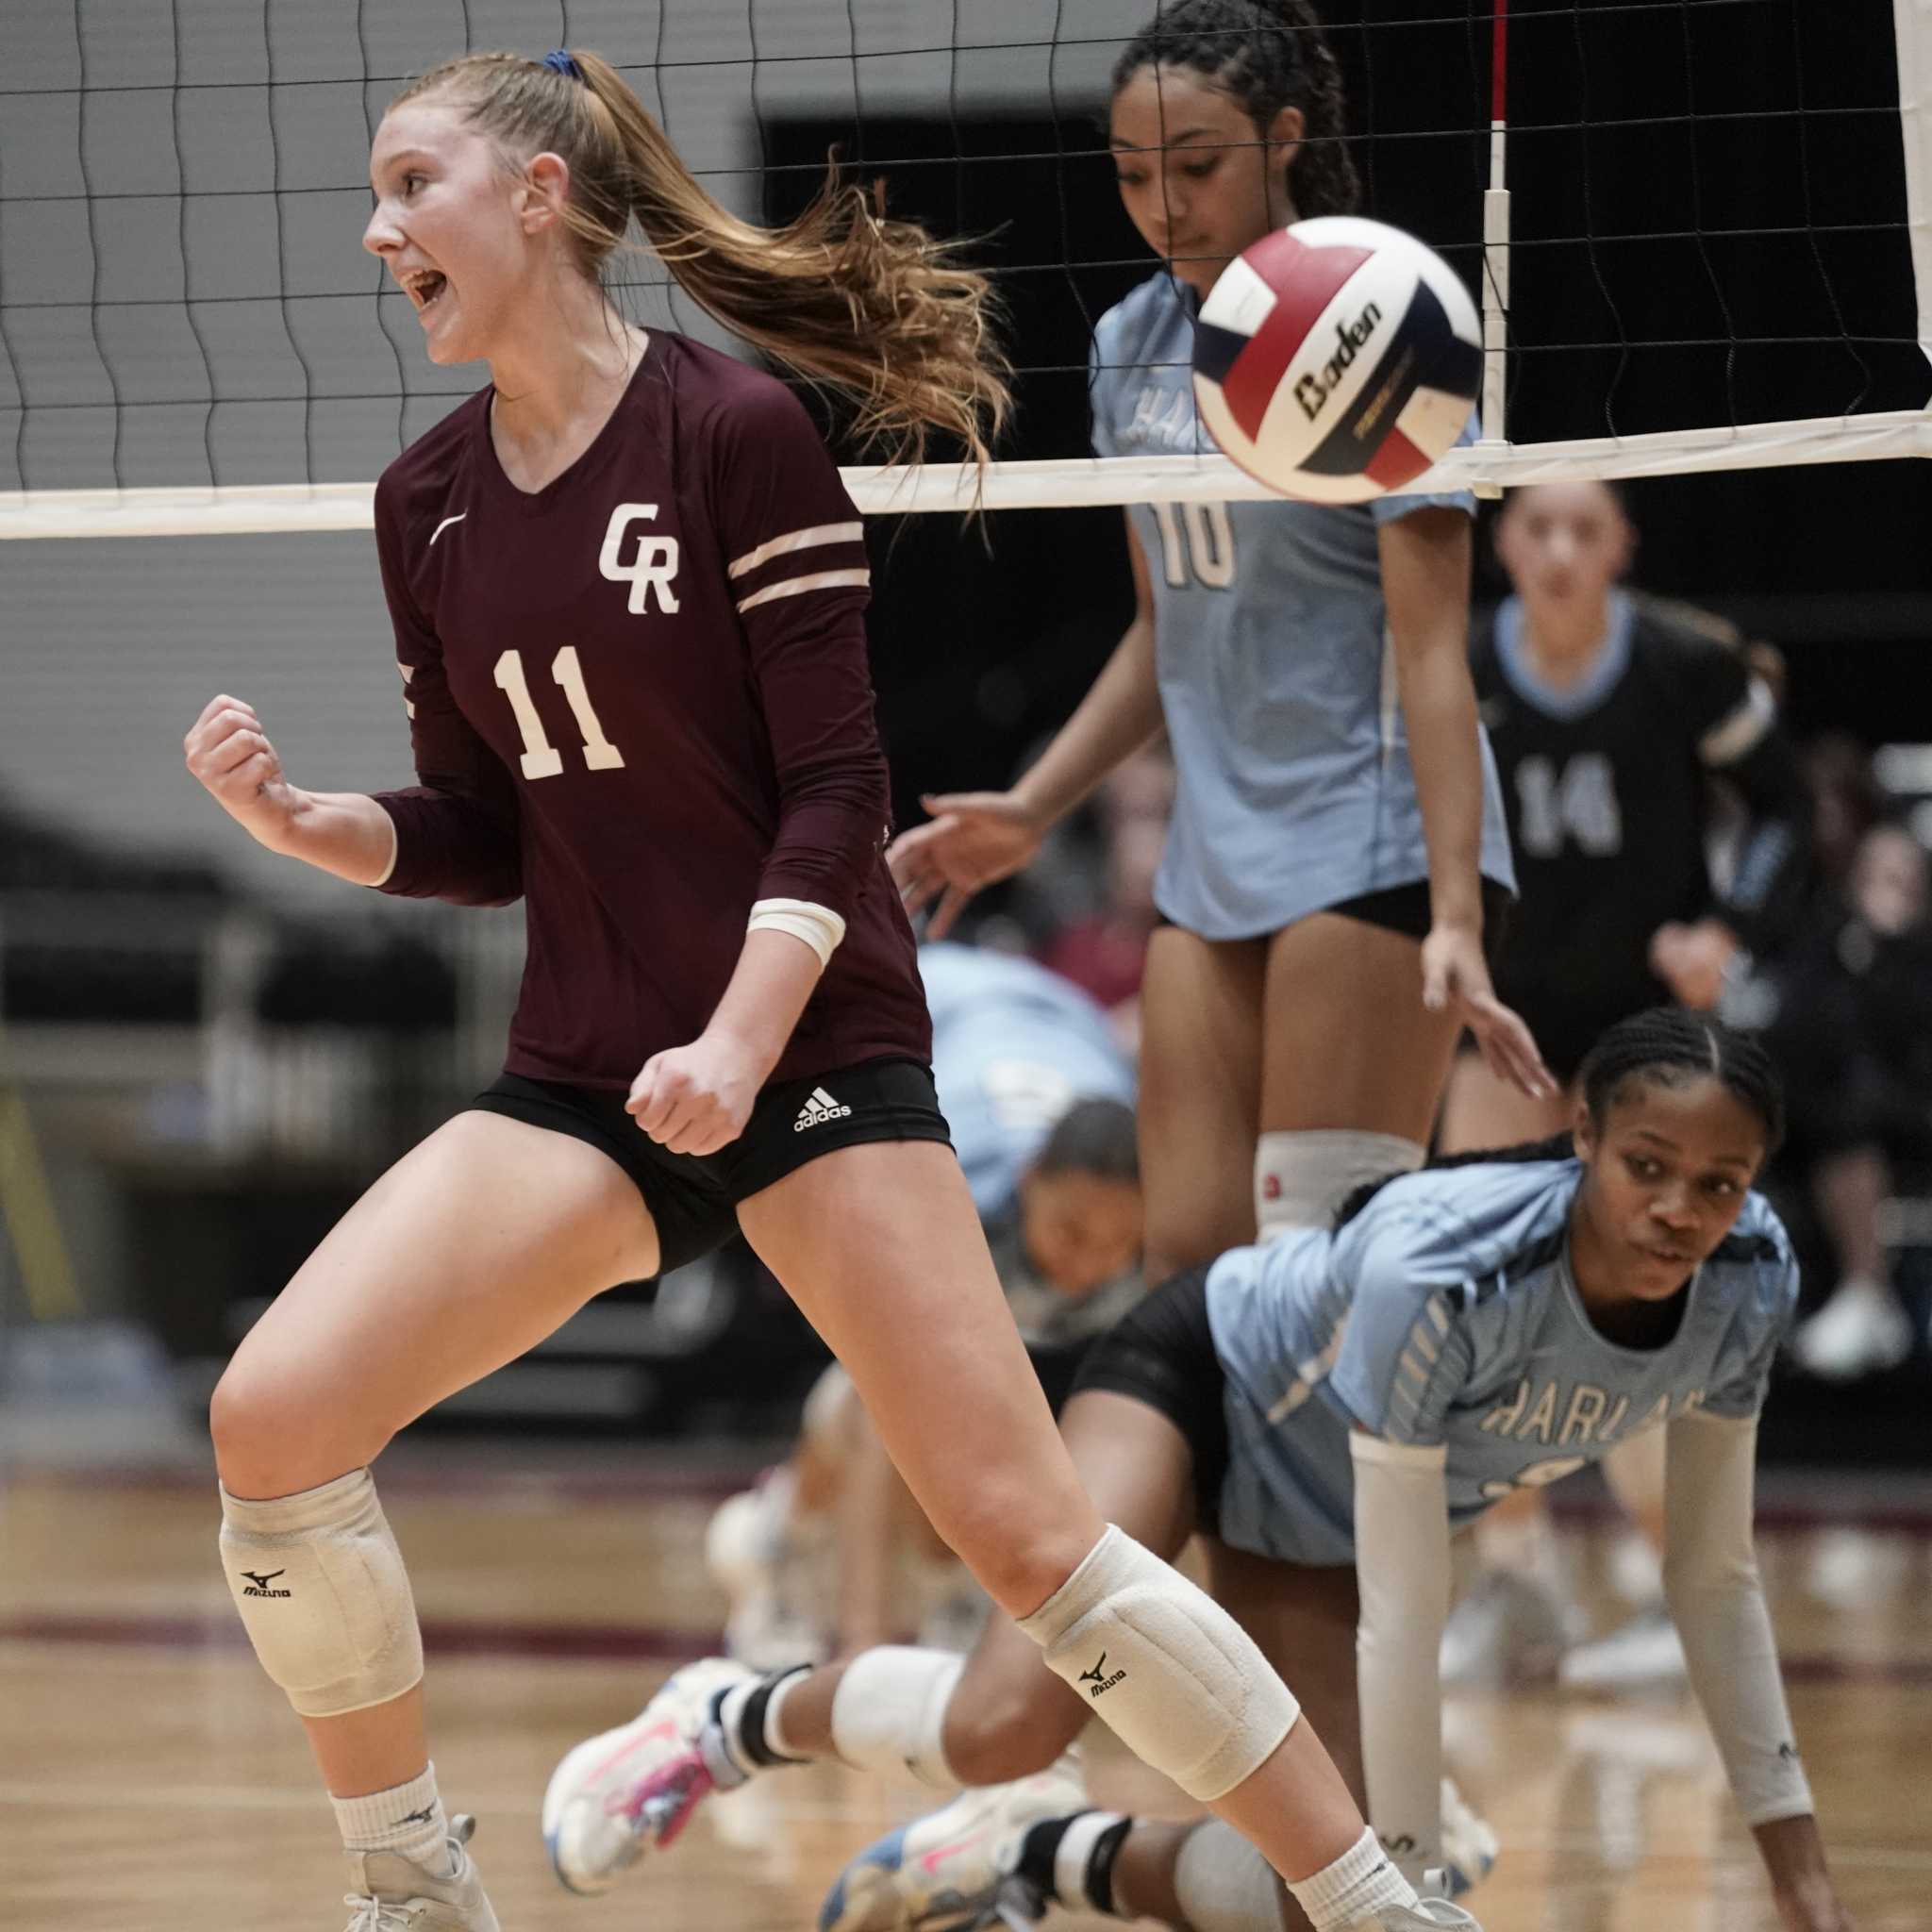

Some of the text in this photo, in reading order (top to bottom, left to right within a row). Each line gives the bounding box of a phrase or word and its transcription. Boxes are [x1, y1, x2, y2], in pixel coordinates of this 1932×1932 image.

[1292, 300, 1383, 423] Baden
[599, 503, 680, 615] CR
[1147, 501, 1235, 589] 10
[493, 645, 625, 780] 11
[793, 1105, 852, 1132] adidas
